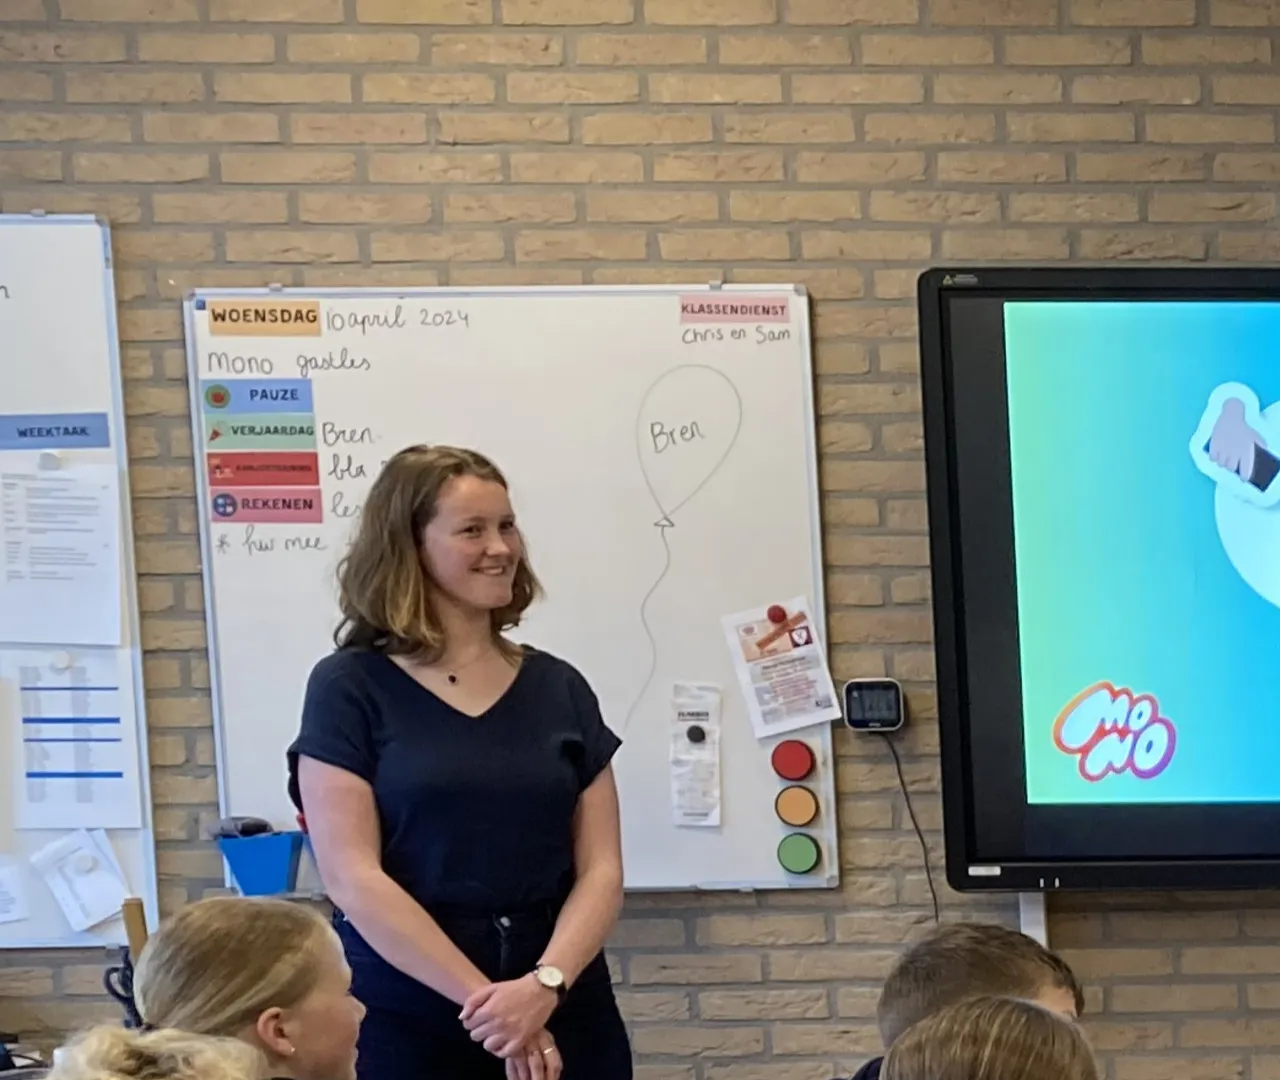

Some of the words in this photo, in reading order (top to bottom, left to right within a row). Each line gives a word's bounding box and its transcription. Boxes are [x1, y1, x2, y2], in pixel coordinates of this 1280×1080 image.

[211, 308, 318, 324] WOENSDAG
[681, 303, 787, 316] KLASSENDIENST
[326, 310, 345, 331] 10
[349, 305, 406, 335] april
[419, 308, 470, 328] 2024
[681, 328, 724, 345] Chris
[730, 328, 746, 340] en
[755, 325, 791, 345] Sam
[207, 351, 274, 375] Mono
[296, 347, 371, 378] gastles
[249, 388, 300, 401] PAUZE
[16, 425, 90, 439] WEEKTAAK
[230, 425, 315, 437] VERJAARDAG
[321, 421, 376, 447] Bren
[649, 420, 706, 454] Bren
[327, 453, 367, 479] bla
[240, 497, 314, 511] REKENEN
